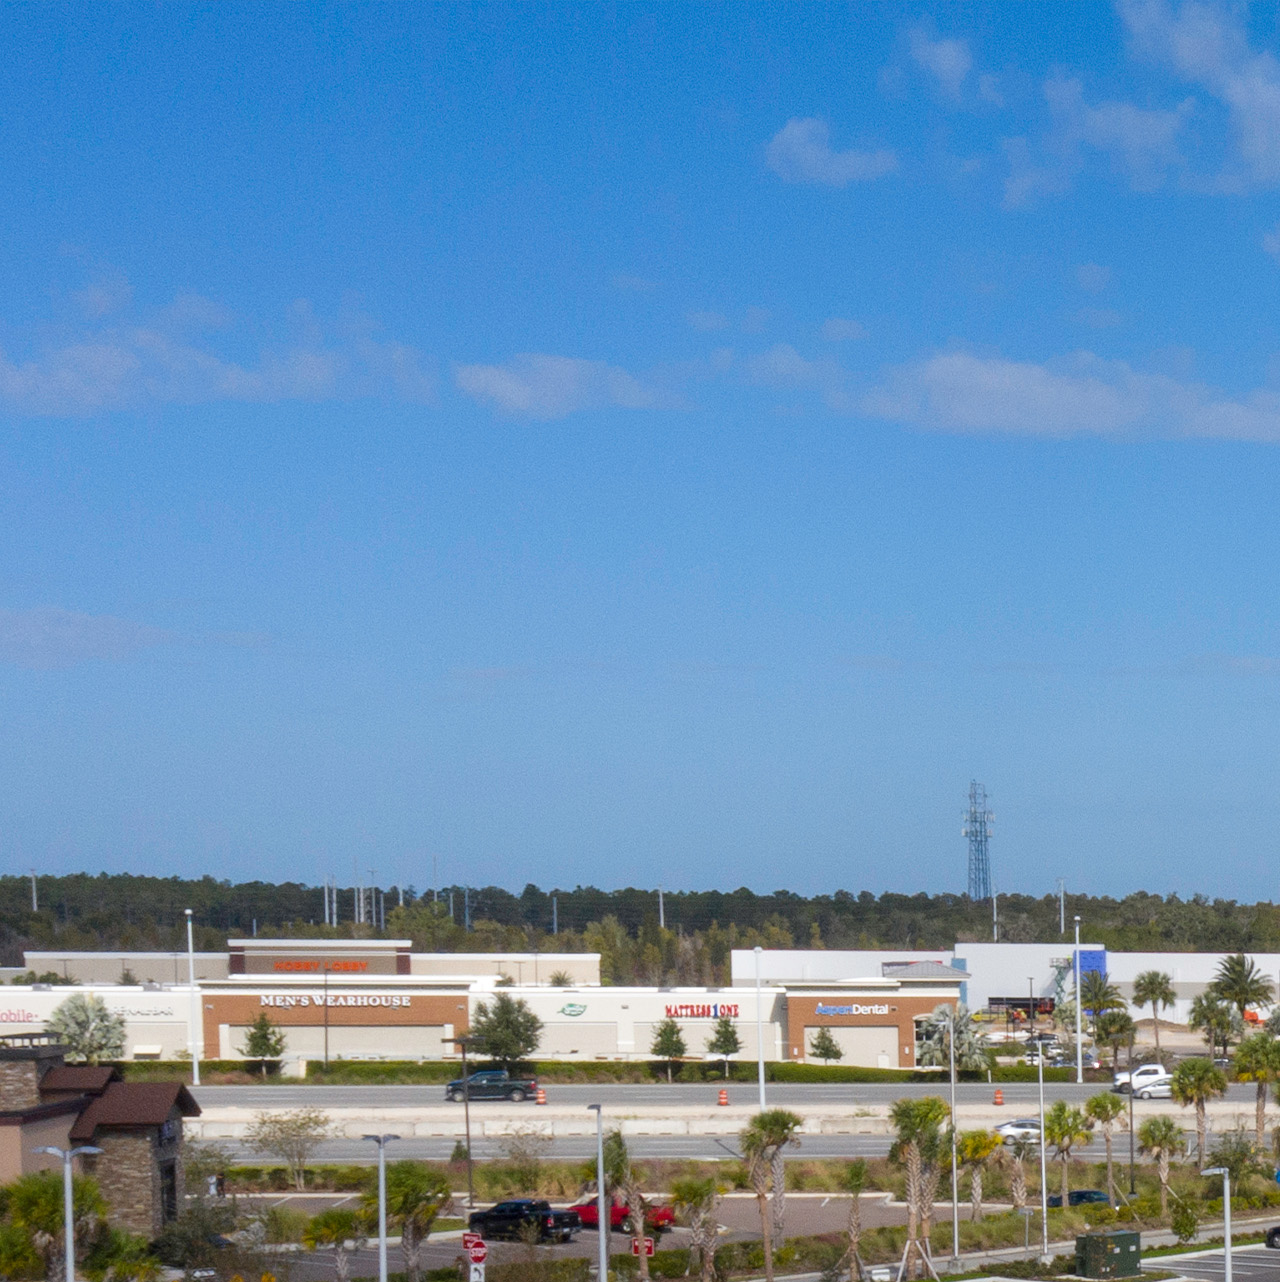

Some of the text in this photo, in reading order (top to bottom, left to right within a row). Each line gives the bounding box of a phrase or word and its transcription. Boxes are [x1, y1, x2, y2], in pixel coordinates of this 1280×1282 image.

[260, 995, 411, 1007] MEN'S WEARHOUSE
[0, 1009, 33, 1022] obile
[665, 1004, 711, 1018] MATTRESS
[720, 1004, 739, 1018] ONE
